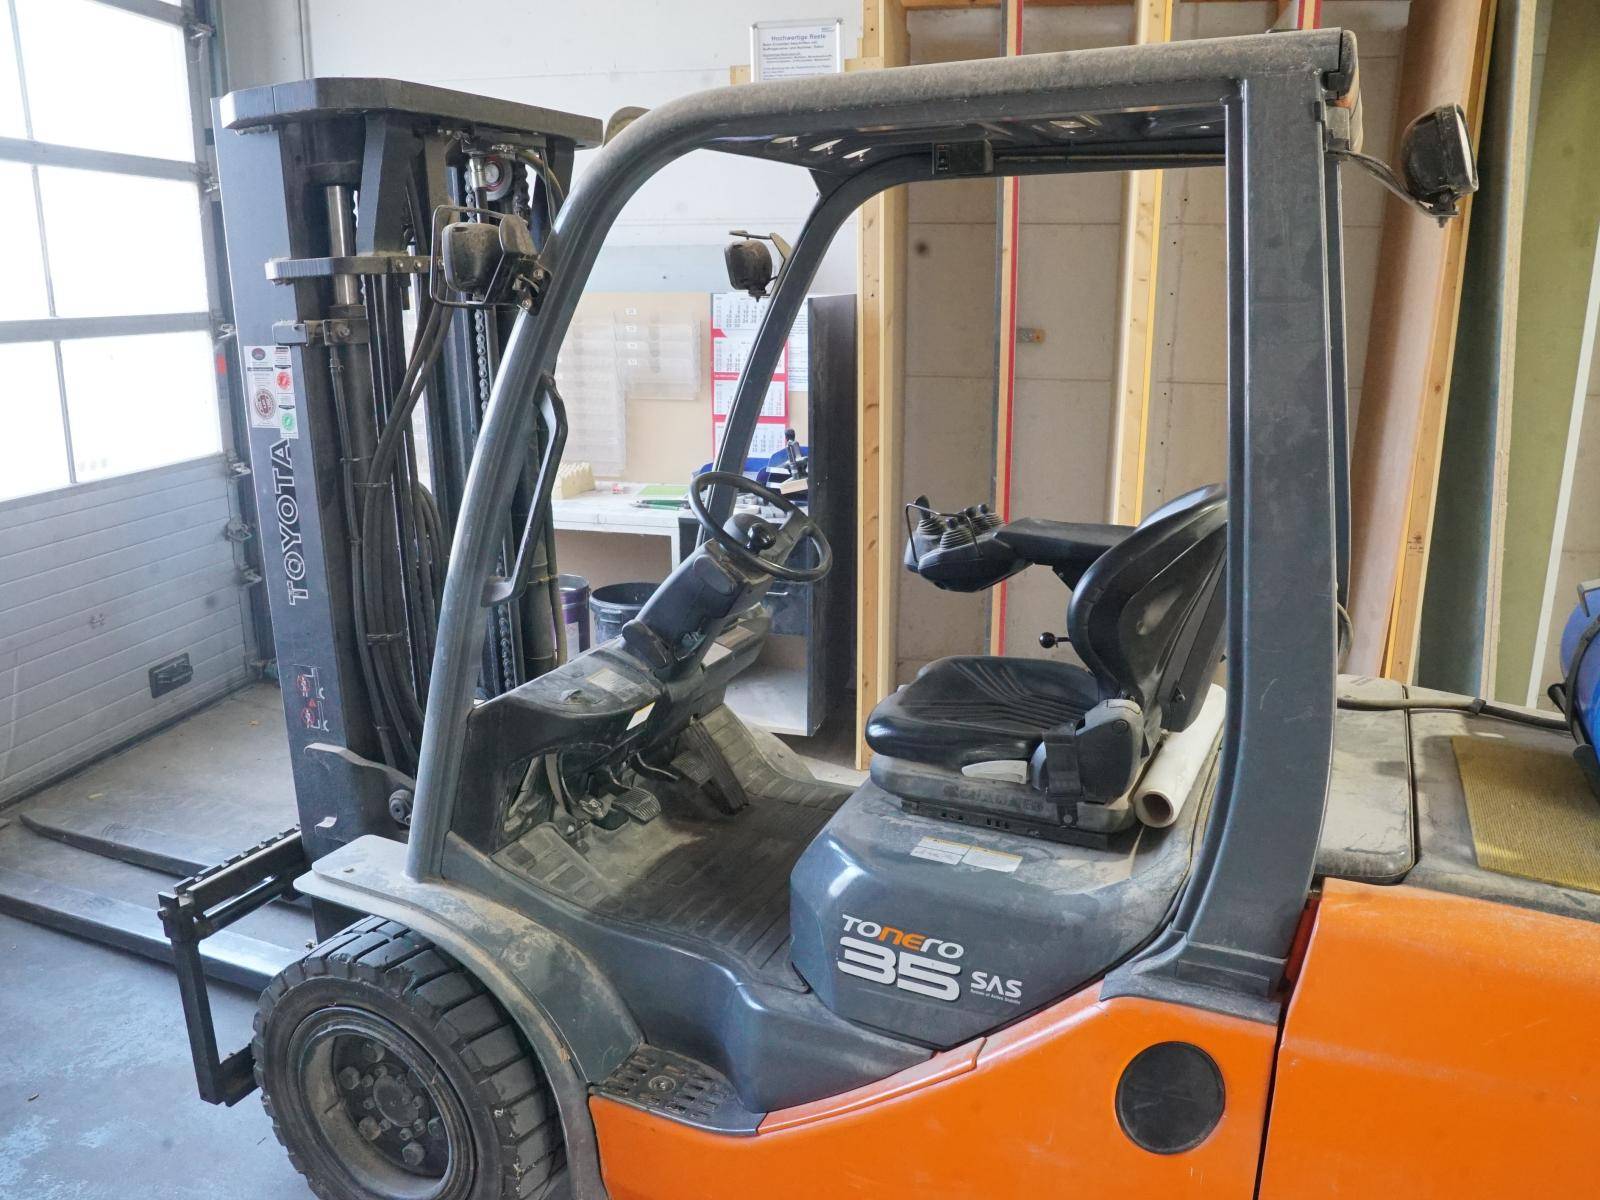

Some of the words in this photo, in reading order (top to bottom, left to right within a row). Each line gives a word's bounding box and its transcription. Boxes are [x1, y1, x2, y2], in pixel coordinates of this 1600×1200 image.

[270, 438, 308, 606] TOYOTA
[837, 936, 962, 1001] 35
[970, 971, 1022, 998] SAS
